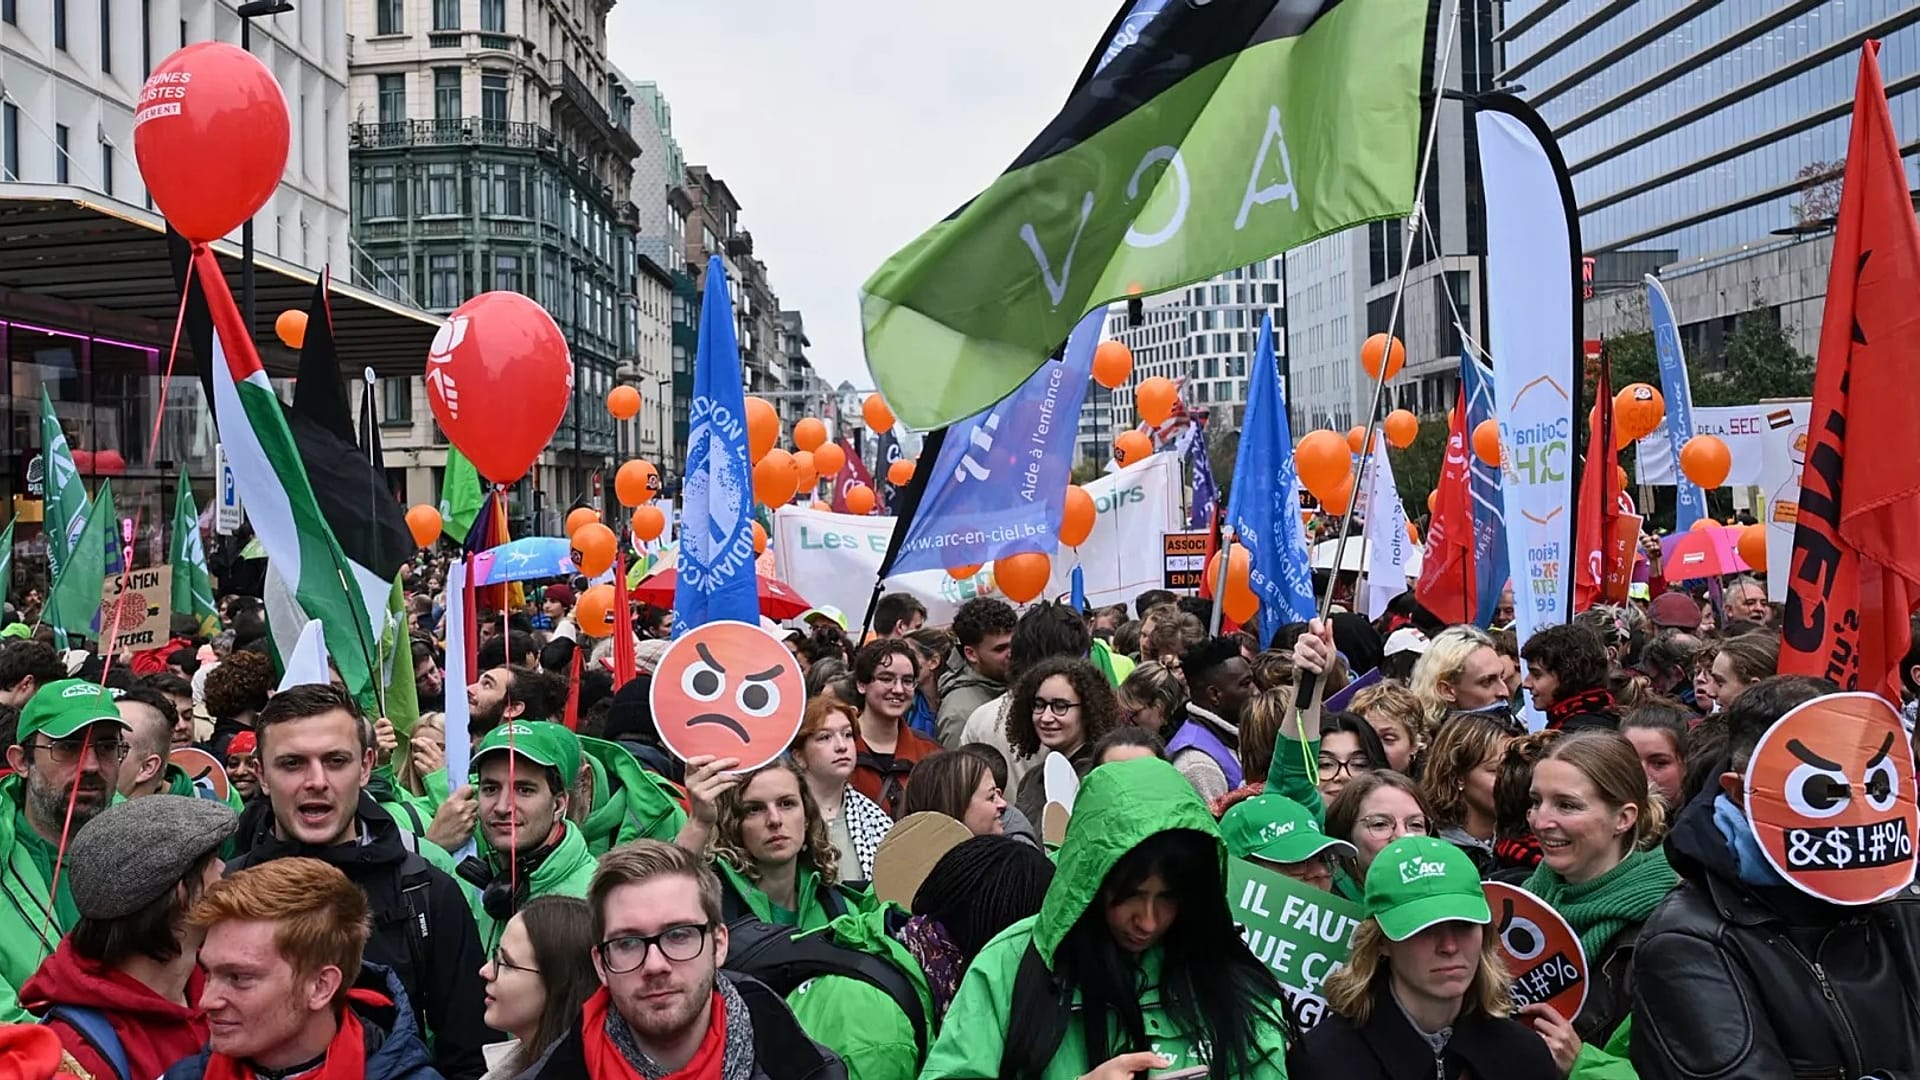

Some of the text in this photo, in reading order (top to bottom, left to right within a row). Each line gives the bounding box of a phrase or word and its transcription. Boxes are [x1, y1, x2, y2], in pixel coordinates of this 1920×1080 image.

[1020, 463, 1041, 502] Aide
[1031, 368, 1064, 444] l'enfance
[1729, 417, 1760, 434] SEC
[1095, 485, 1145, 514] oirs
[801, 526, 858, 550] Les
[1167, 539, 1207, 551] ASSOCI
[113, 571, 160, 595] SAMEN
[1240, 879, 1361, 950] IL FAUT
